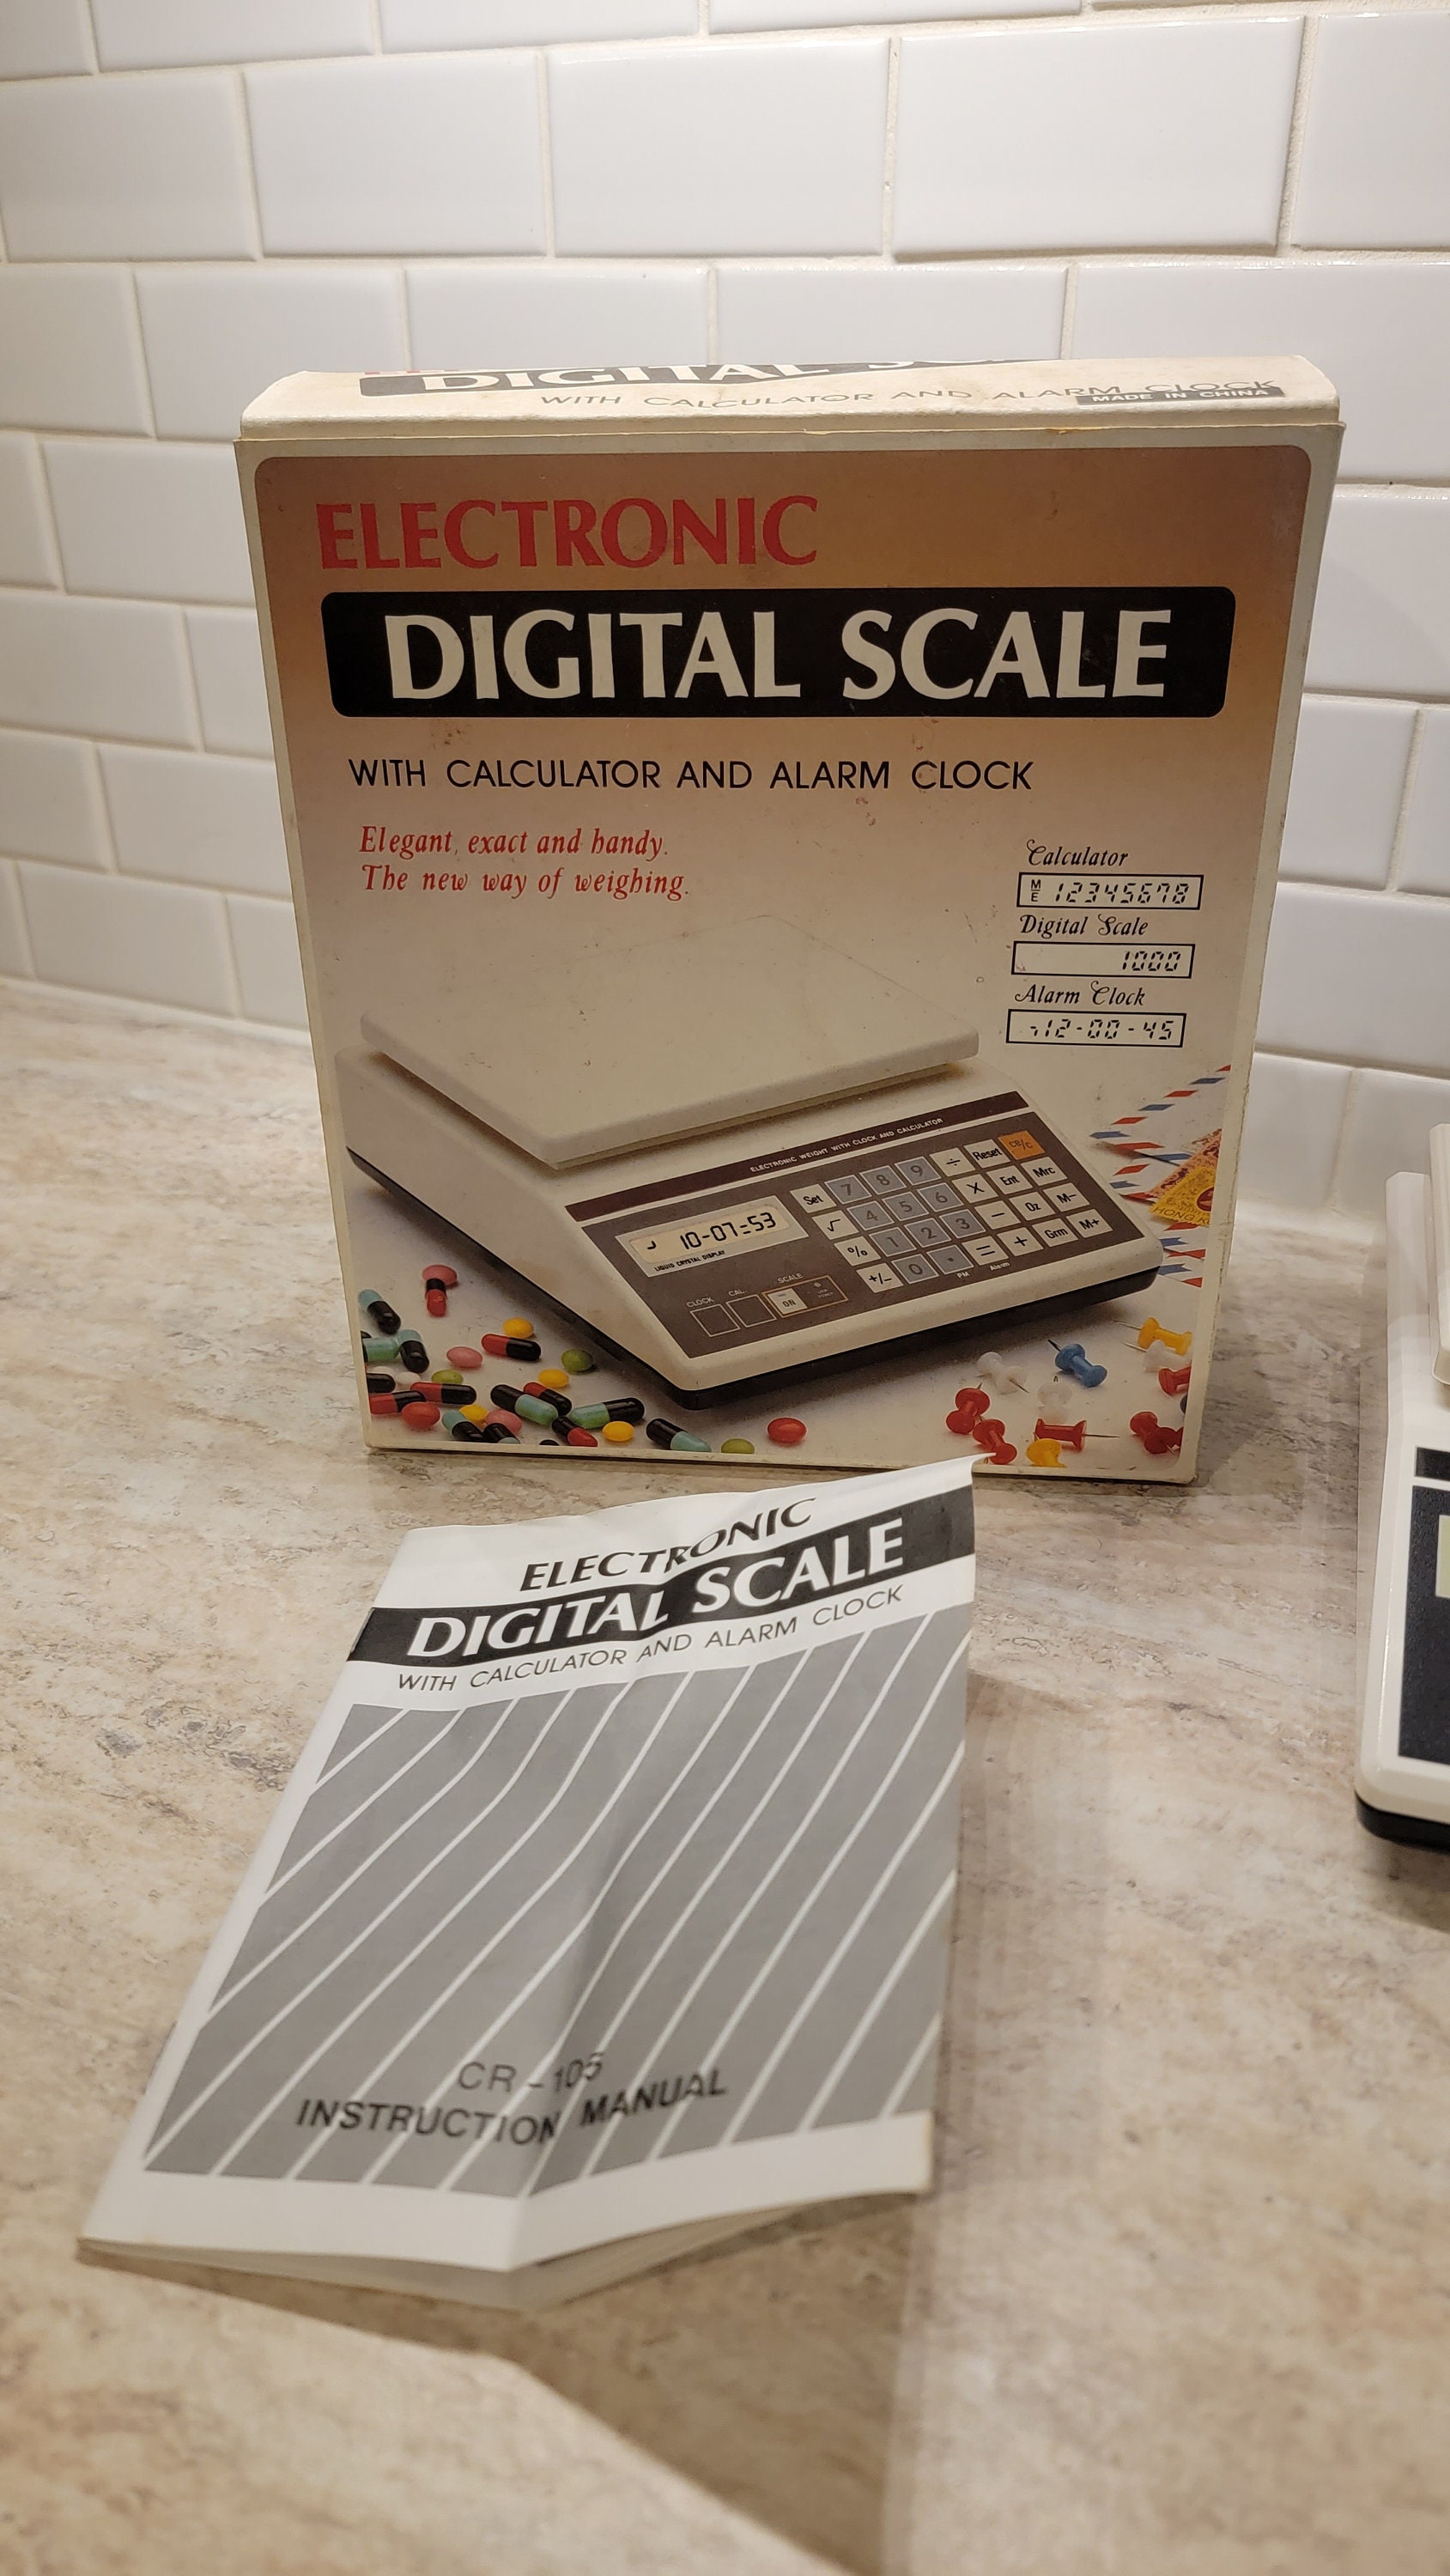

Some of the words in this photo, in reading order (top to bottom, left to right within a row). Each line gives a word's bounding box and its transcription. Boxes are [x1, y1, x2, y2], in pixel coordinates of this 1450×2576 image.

[644, 393, 874, 408] CALCULATOR
[891, 390, 972, 399] AND
[992, 386, 1120, 400] ALARM
[1145, 380, 1275, 393] CLOCK
[1092, 393, 1153, 402] MADE
[1198, 389, 1270, 398] CHINA
[316, 495, 818, 570] ELECTRONIC
[385, 609, 801, 699] DIGITAL
[841, 608, 1171, 700] SCALE
[349, 759, 426, 787] WITH
[446, 759, 660, 788] CALCULATOR
[676, 762, 752, 788] AND
[768, 762, 889, 789] ALARM
[911, 762, 1034, 790] CLOCK
[468, 831, 529, 854] exact
[537, 828, 582, 854] and
[591, 828, 669, 861] handy.
[1026, 839, 1129, 866] Calculator
[361, 864, 409, 890] The
[422, 872, 468, 890] new
[482, 872, 527, 899] way
[537, 867, 565, 899] of
[574, 868, 689, 902] weighing.
[1055, 883, 1190, 904] 12345678
[1020, 914, 1089, 939] Digital
[1097, 914, 1149, 936] Scale
[1122, 951, 1181, 971] 1000
[1014, 984, 1081, 1004] Alarm
[1090, 981, 1146, 1006] Clock
[749, 1156, 798, 1172] ELECTRONIC
[799, 1147, 829, 1160] WEIGHT
[831, 1142, 852, 1152] WITH
[852, 1135, 879, 1146] CLOCK
[879, 1130, 895, 1139] AND
[896, 1118, 943, 1134] CALCULATOR
[973, 1147, 1003, 1161] Reset
[910, 1164, 924, 1177] 9
[1034, 1166, 1056, 1178] Mrc
[876, 1174, 890, 1187] 8
[999, 1176, 1021, 1187] Ent
[840, 1183, 852, 1196] 7
[803, 1194, 824, 1206] Set
[935, 1191, 949, 1204] 6
[900, 1200, 913, 1213] 5
[1024, 1201, 1041, 1212] Oz
[866, 1210, 878, 1222] 4
[1153, 1207, 1196, 1220] HONG
[955, 1218, 971, 1230] 3
[1078, 1218, 1100, 1230] M+
[920, 1226, 937, 1240] 2
[1044, 1227, 1069, 1240] Grm
[885, 1236, 900, 1249] 1
[847, 1245, 869, 1259] %
[654, 1263, 675, 1272] LIQUID
[676, 1256, 701, 1266] CRYSTAL
[701, 1249, 725, 1260] DISPLAY
[989, 1261, 1010, 1271] Alarm
[777, 1272, 804, 1284] SCALE
[728, 1289, 748, 1297] CAL.
[686, 1297, 714, 1308] CLOCK
[782, 1298, 796, 1307] ON
[519, 1497, 817, 1592] ELECTRONIC
[406, 1589, 669, 1658] DIGITAL
[691, 1517, 907, 1615] SCALE
[397, 1673, 456, 1692] WITH
[469, 1649, 628, 1689] CALCULATOR
[635, 1633, 693, 1664] AND
[704, 1616, 798, 1649] ALARM
[812, 1583, 904, 1628] CLOCK
[458, 2062, 515, 2092] CR
[555, 2052, 603, 2094] 105
[296, 2099, 560, 2145] INSTRUCTION
[579, 2069, 726, 2127] MANUAL
